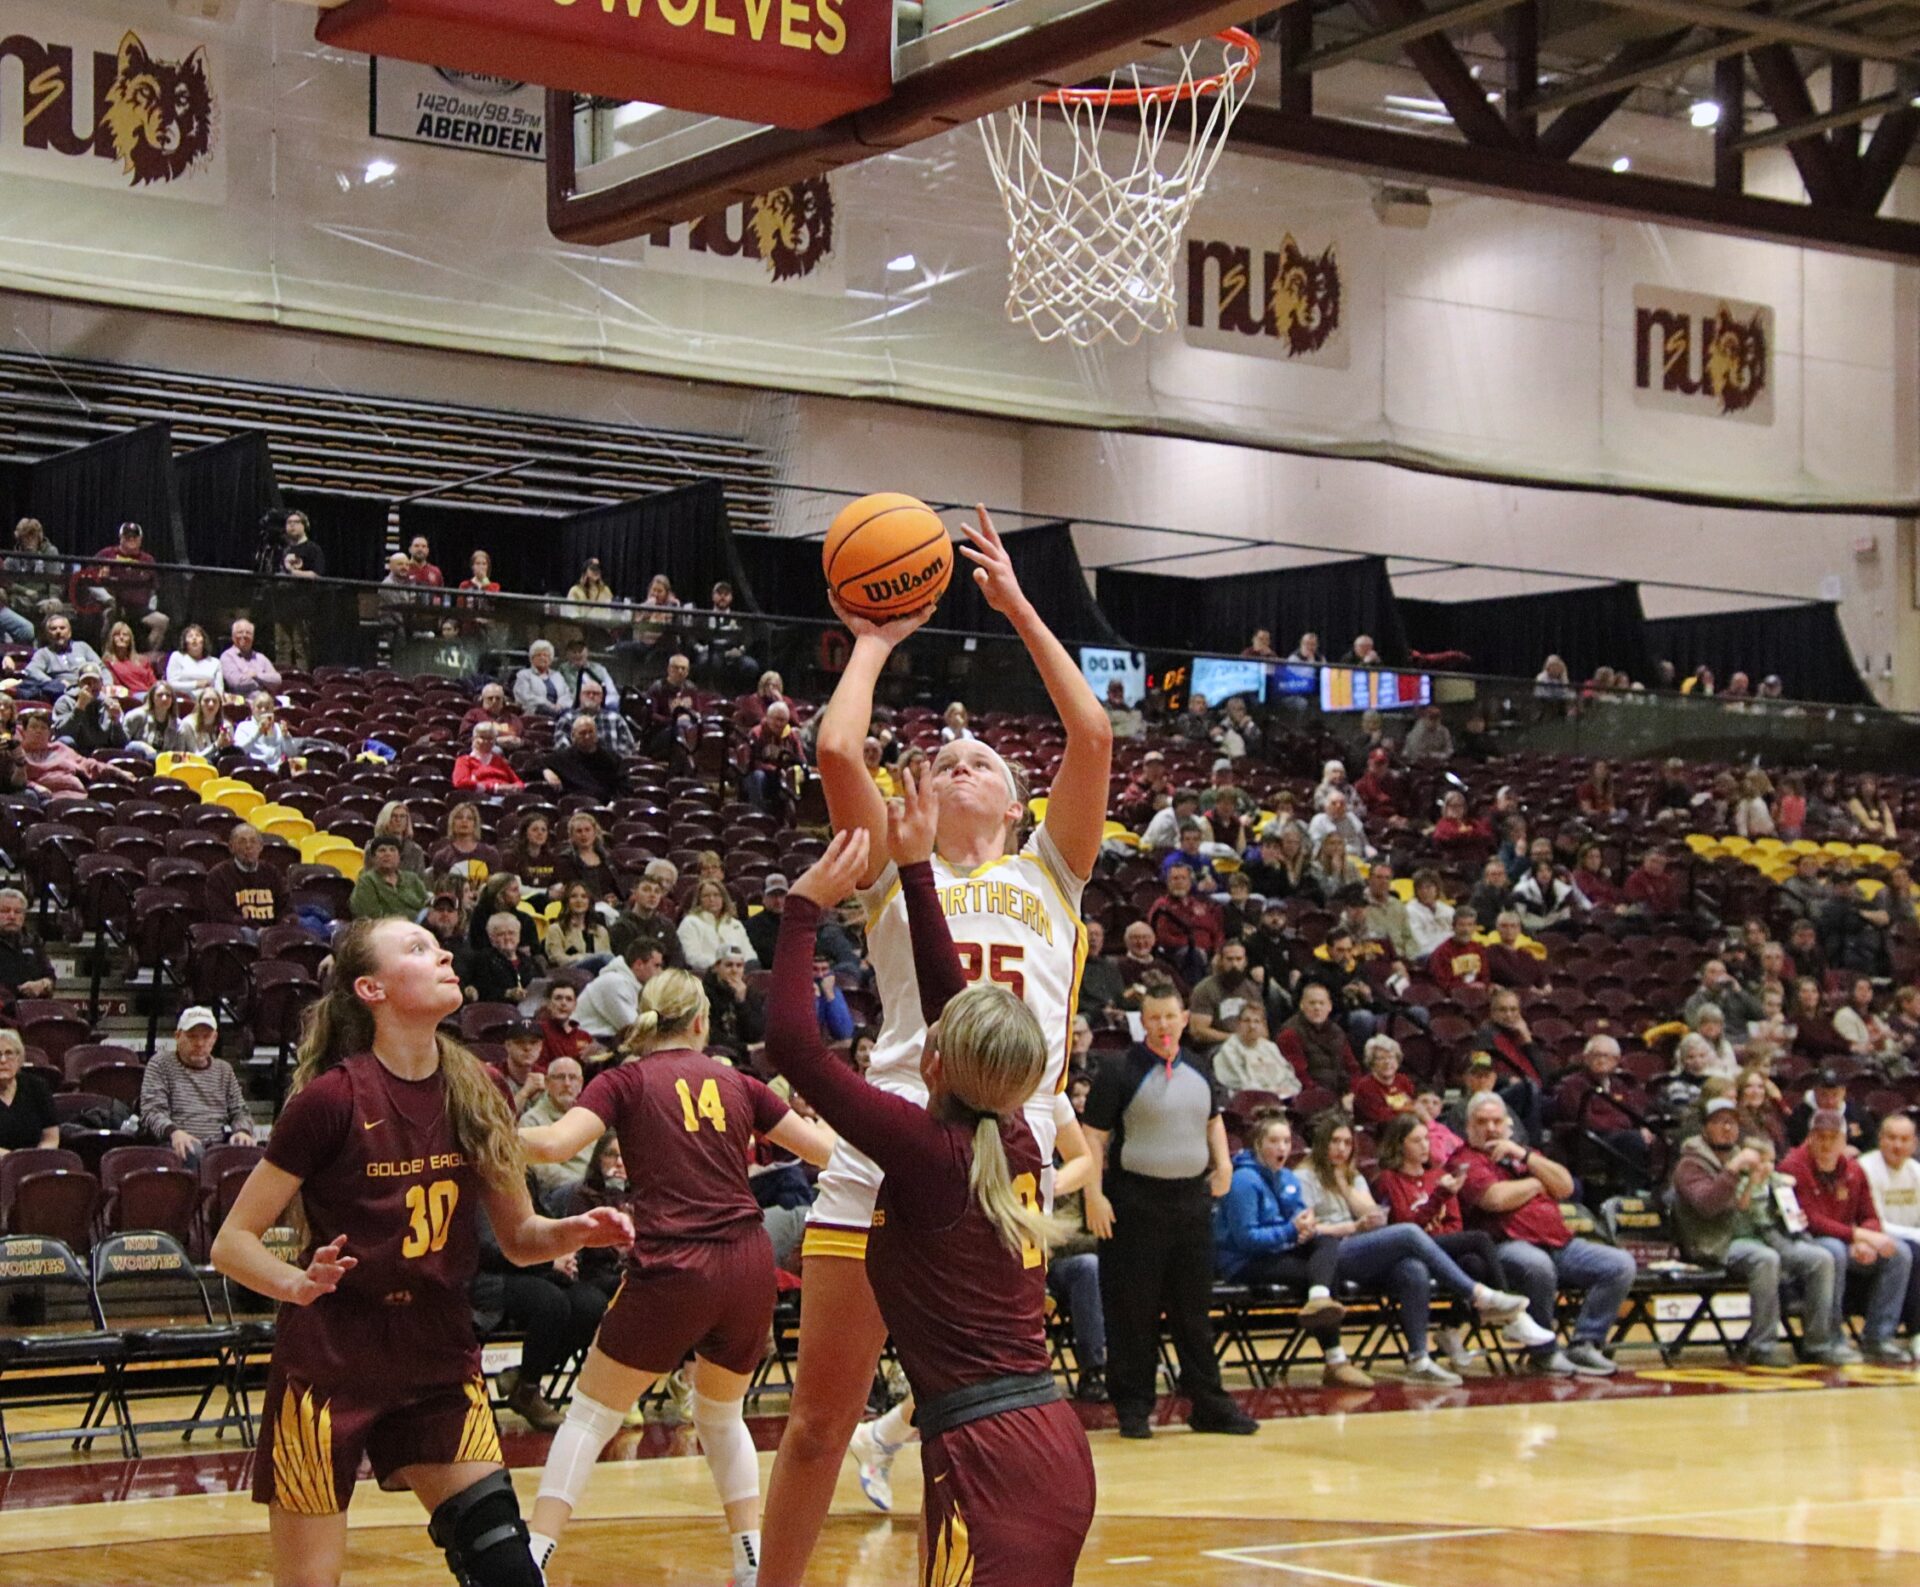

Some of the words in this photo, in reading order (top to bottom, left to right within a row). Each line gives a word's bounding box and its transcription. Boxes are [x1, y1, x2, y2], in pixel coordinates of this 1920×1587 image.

[416, 92, 541, 128] 1420AM/98.5FM
[416, 113, 543, 154] ABERDEEN
[862, 556, 944, 602] Wilson
[675, 1078, 727, 1133] 14
[402, 1180, 459, 1259] 30
[5, 1239, 42, 1256] NSU
[122, 1235, 158, 1250] NSU
[108, 1254, 182, 1272] WOLVES
